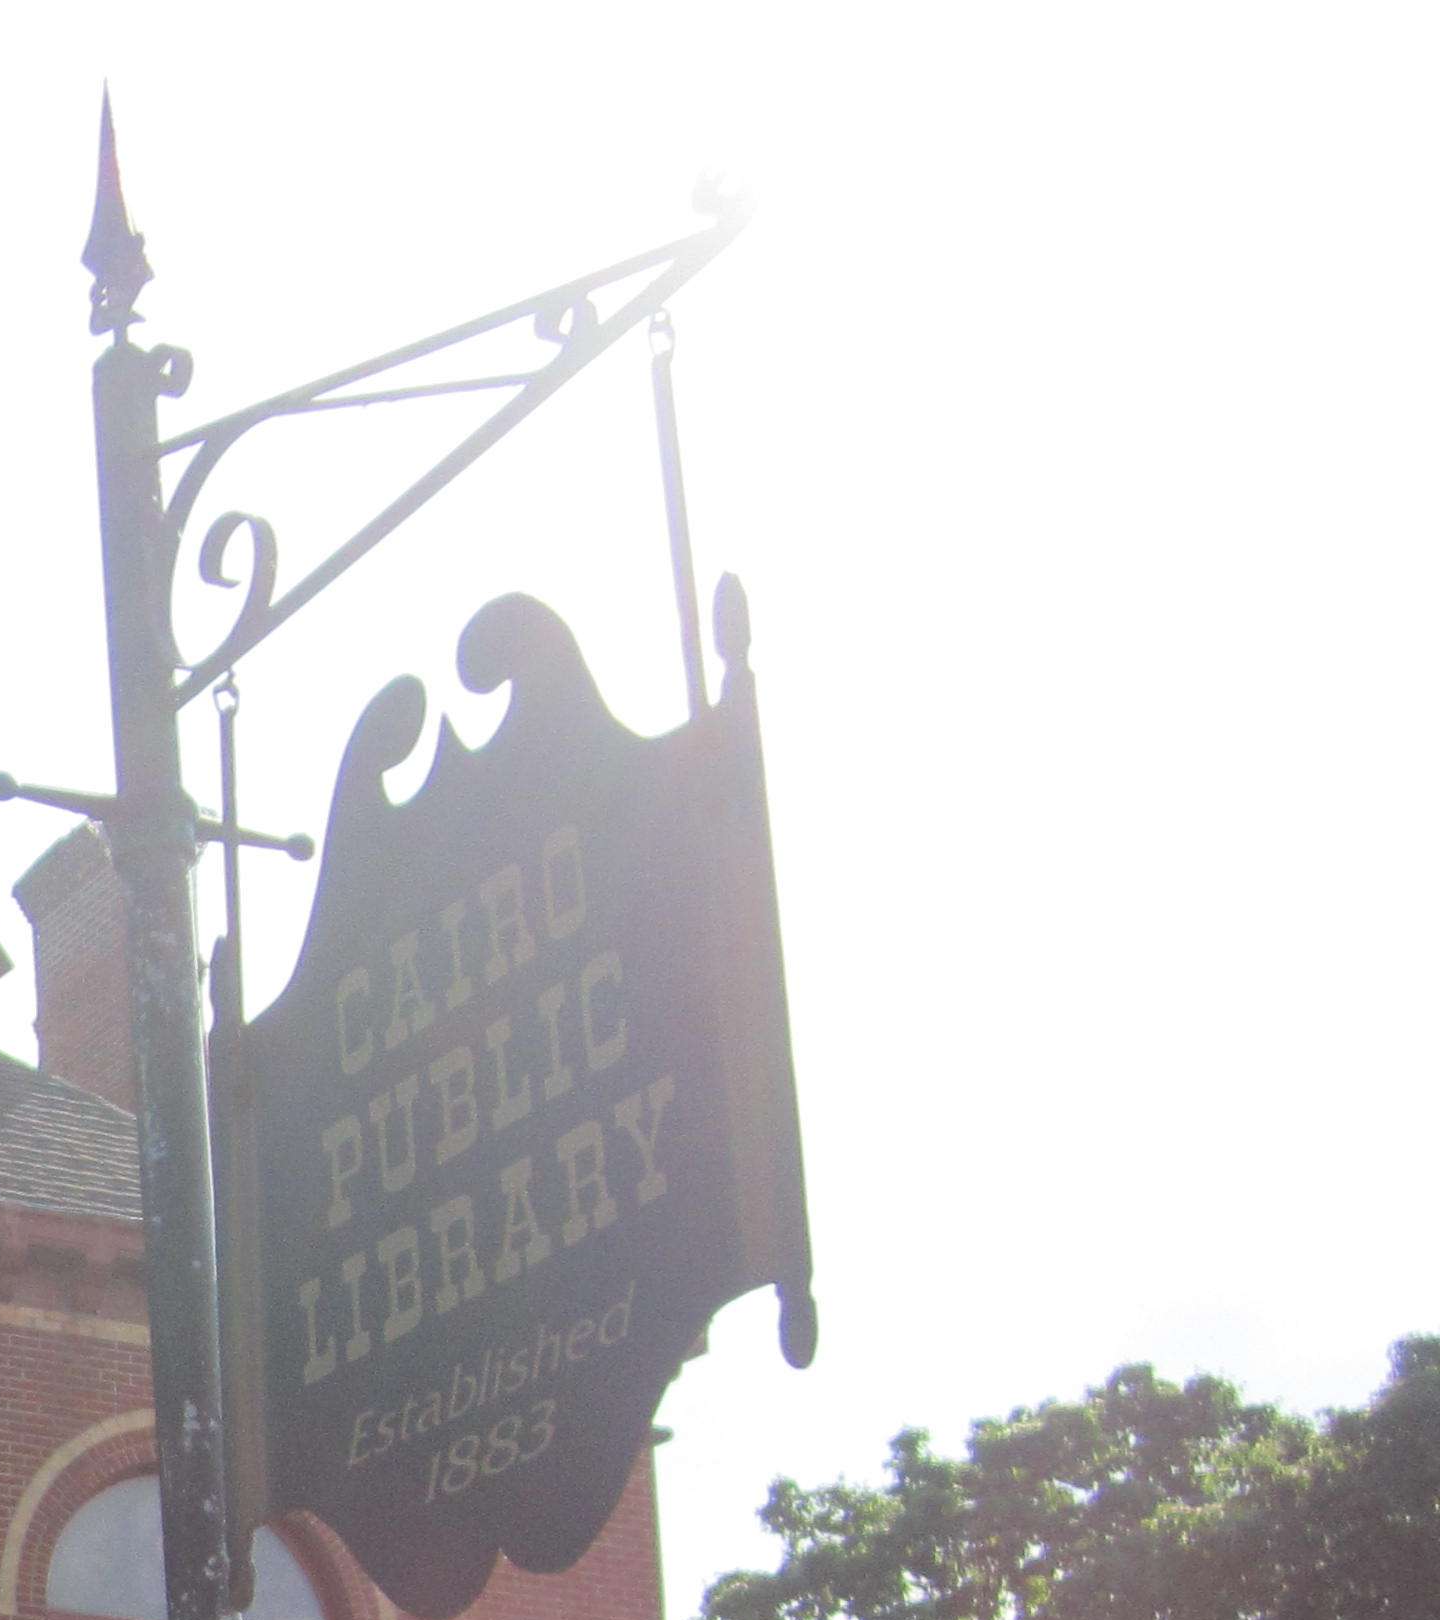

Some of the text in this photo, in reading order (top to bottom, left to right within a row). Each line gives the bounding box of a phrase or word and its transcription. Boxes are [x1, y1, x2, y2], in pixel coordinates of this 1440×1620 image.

[336, 825, 587, 1075] CAIRO
[322, 951, 629, 1229] PUBLIC
[299, 1075, 675, 1386] LIBRARY
[346, 1281, 636, 1470] Established
[424, 1399, 558, 1504] 1883
